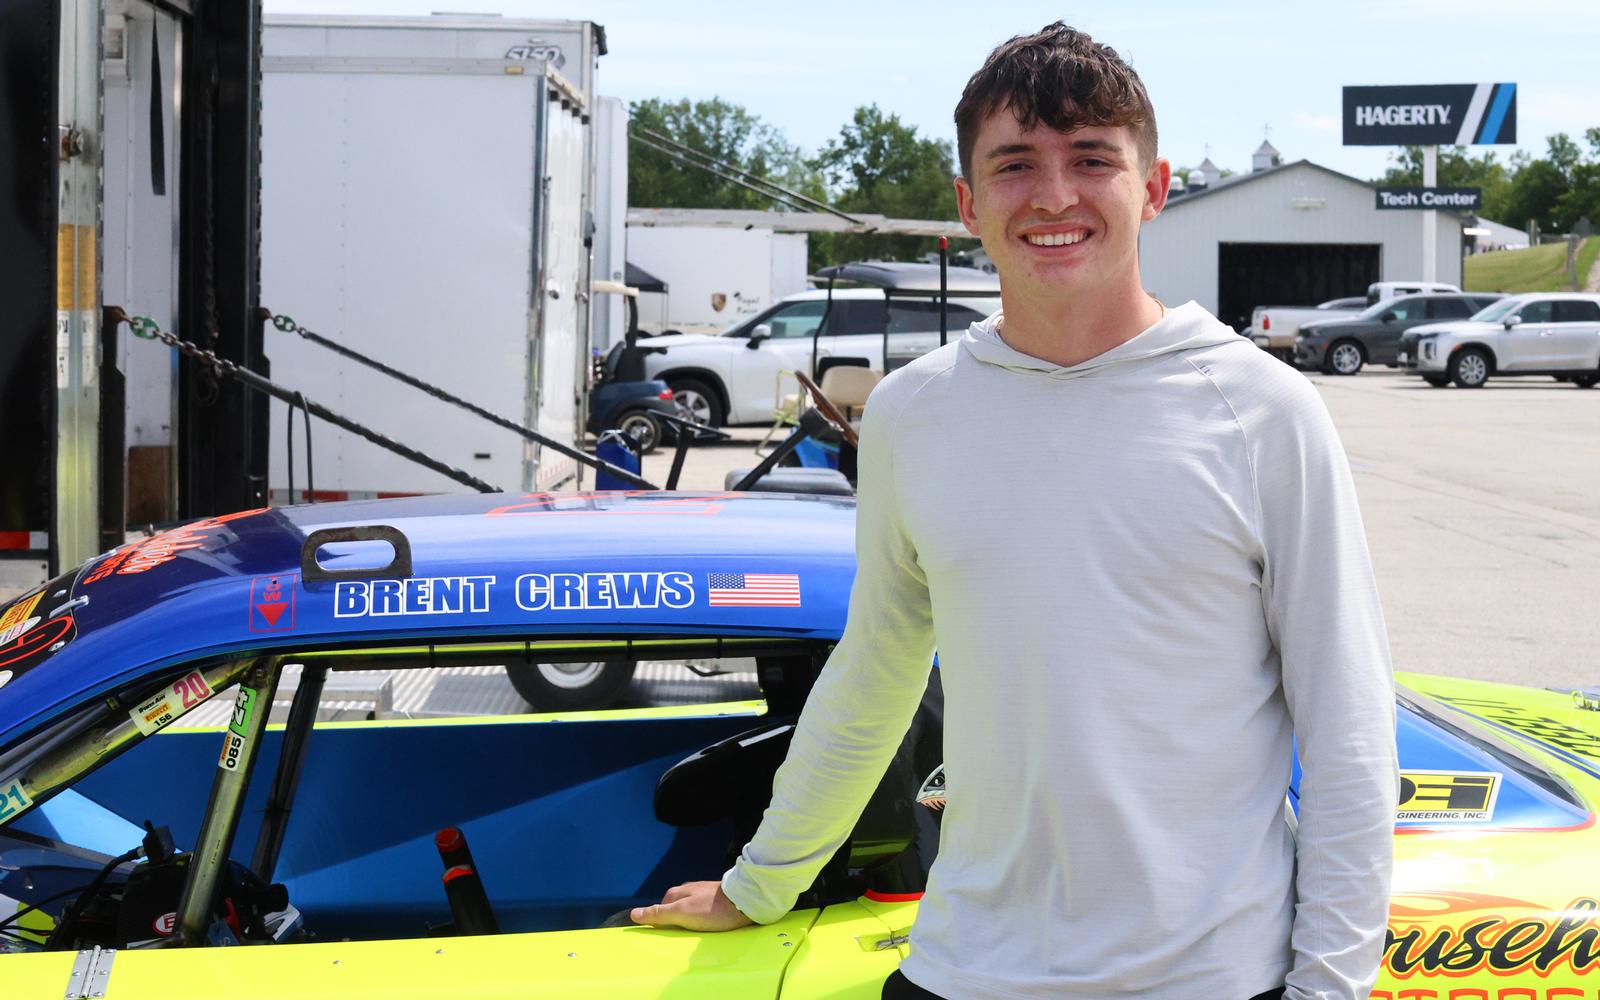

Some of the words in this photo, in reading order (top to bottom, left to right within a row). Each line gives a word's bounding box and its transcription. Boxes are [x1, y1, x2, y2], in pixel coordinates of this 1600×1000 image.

[1356, 104, 1451, 126] HAGERTY
[1380, 191, 1418, 205] Tech
[1421, 191, 1477, 205] Center
[263, 576, 283, 602] TOW
[334, 575, 496, 618] BRENT
[515, 572, 695, 611] CREWS
[173, 671, 210, 709] 20
[154, 713, 172, 726] 156
[226, 737, 242, 769] 085
